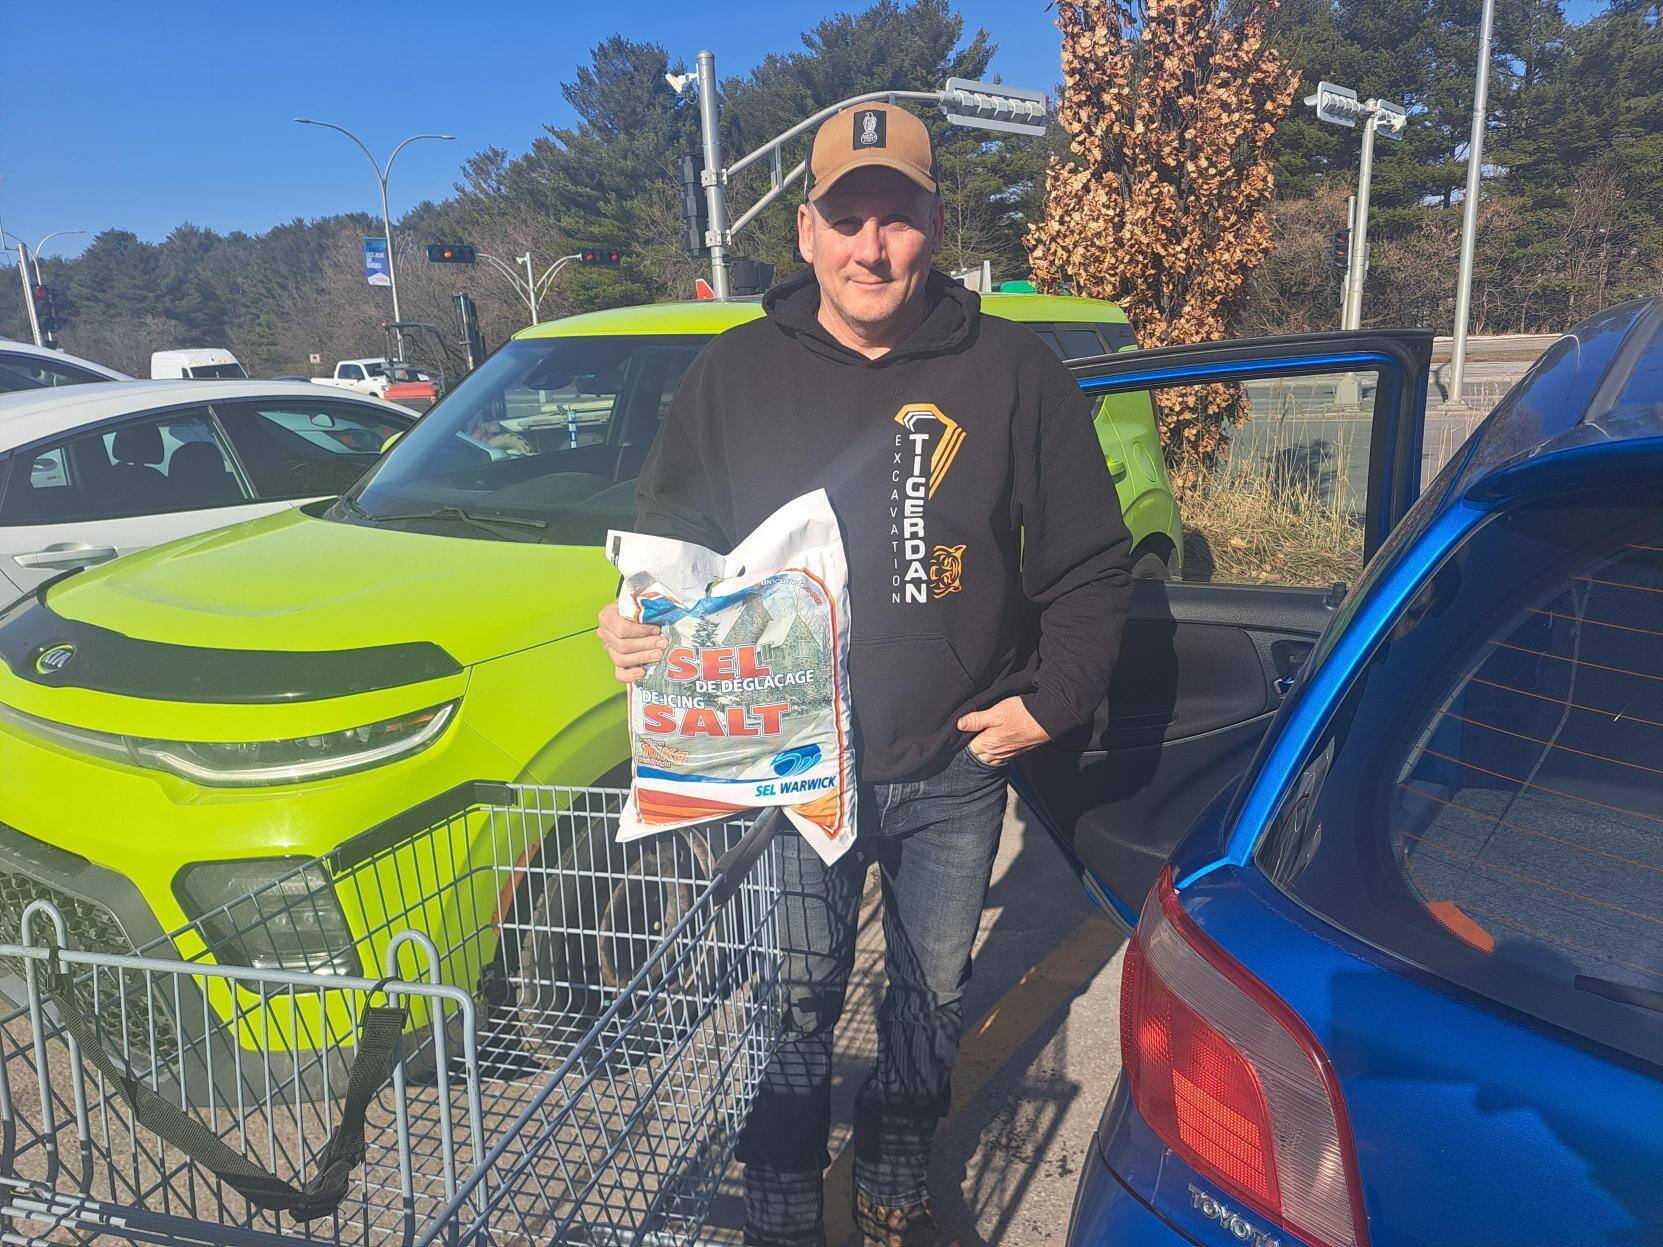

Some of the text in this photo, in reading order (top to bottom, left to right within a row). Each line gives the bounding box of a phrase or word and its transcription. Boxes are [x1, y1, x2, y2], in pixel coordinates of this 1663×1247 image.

[889, 434, 902, 604] EXCAVATION
[903, 433, 930, 604] TIGERDAN
[664, 643, 773, 682] SEL
[695, 669, 815, 693] DE DÉGLAÇAGE
[642, 690, 705, 709] DE-ICING
[641, 702, 790, 738] SALT
[755, 775, 837, 797] SEL WARWICK
[1187, 1183, 1281, 1247] TOYOT
